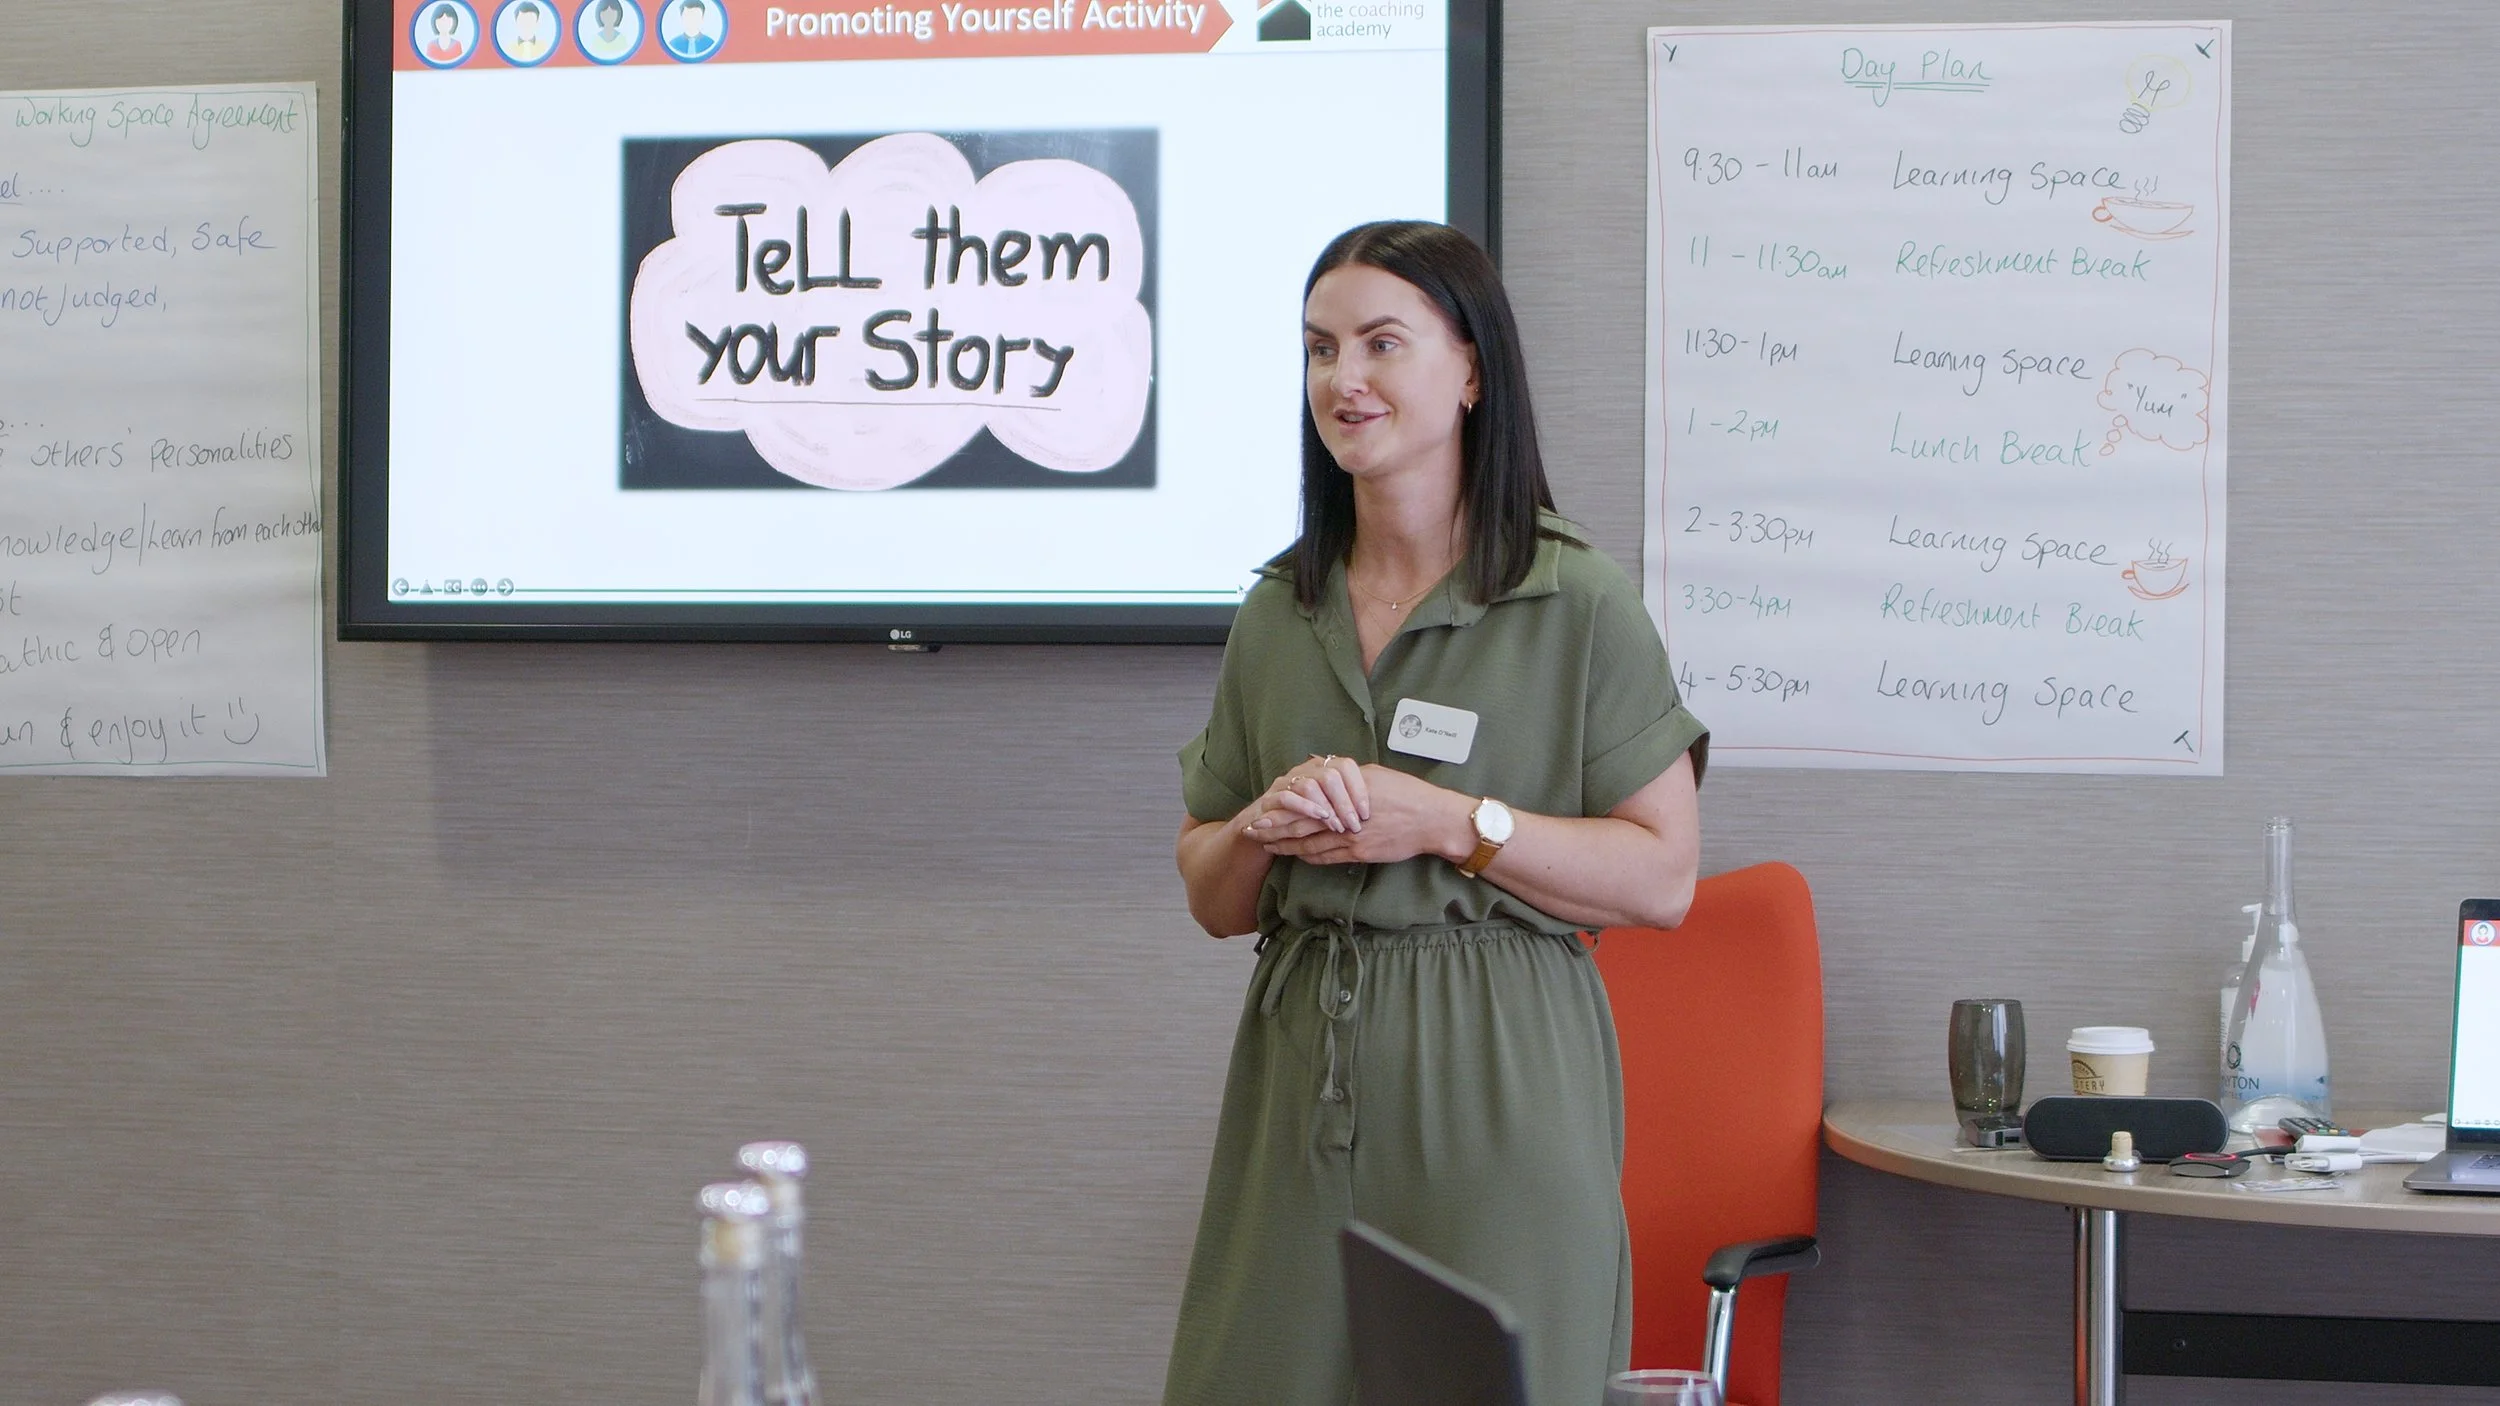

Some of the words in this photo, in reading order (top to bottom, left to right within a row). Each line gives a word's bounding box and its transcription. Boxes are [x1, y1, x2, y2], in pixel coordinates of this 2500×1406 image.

[766, 3, 932, 39] Promoting
[942, 0, 1075, 34] Yourself
[1082, 0, 1206, 33] Activity
[1317, 4, 1344, 18] the
[1349, 0, 1425, 19] coaching
[1317, 21, 1392, 39] academy
[1841, 47, 1898, 106] Day
[1920, 48, 1994, 82] Plan
[16, 97, 98, 147] Working
[107, 101, 174, 139] Space
[186, 94, 299, 150] Agreement
[1683, 147, 1743, 186] 9.30
[1892, 149, 2014, 206] Learning
[2030, 161, 2127, 202] Space
[12, 223, 177, 265] Supported,
[191, 215, 278, 255] Safe
[911, 203, 1110, 290] them
[1688, 236, 1710, 268] 11
[1896, 240, 2061, 280] Refreshment
[2070, 244, 2152, 282] Break
[1, 285, 48, 311] not
[684, 319, 841, 386] your
[861, 306, 1074, 398] Story
[2001, 344, 2093, 383] Space
[1890, 411, 1981, 466] Lunch
[1999, 423, 2093, 468] Break
[1889, 513, 2007, 573] Learning
[2021, 534, 2118, 567] Space
[1881, 589, 2041, 631] Refreshment
[2066, 608, 2144, 641] Break
[1877, 660, 2009, 726] Learning
[2034, 676, 2140, 714] Space
[88, 714, 169, 765] enjoy
